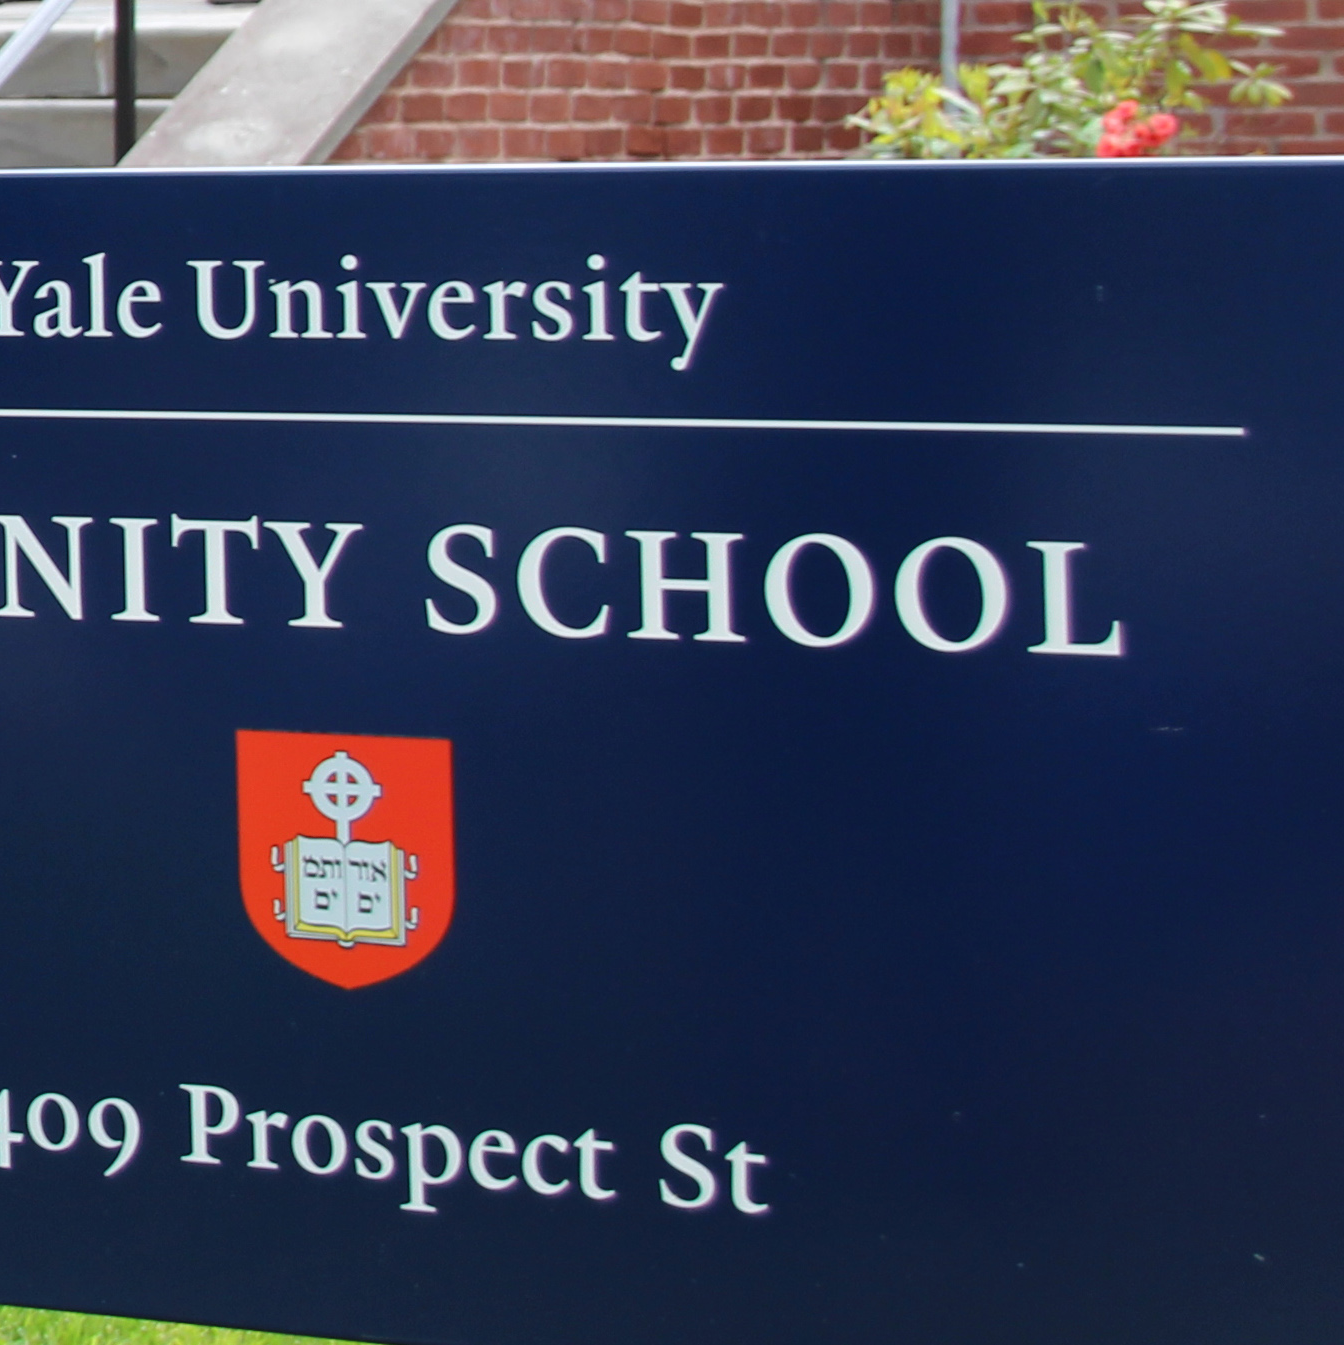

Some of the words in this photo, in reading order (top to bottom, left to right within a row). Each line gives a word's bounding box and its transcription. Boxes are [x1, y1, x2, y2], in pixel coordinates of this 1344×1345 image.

[187, 254, 724, 371] University
[425, 524, 1123, 657] SCHOOL
[179, 1084, 616, 1213] Prospect
[659, 1124, 770, 1214] St
